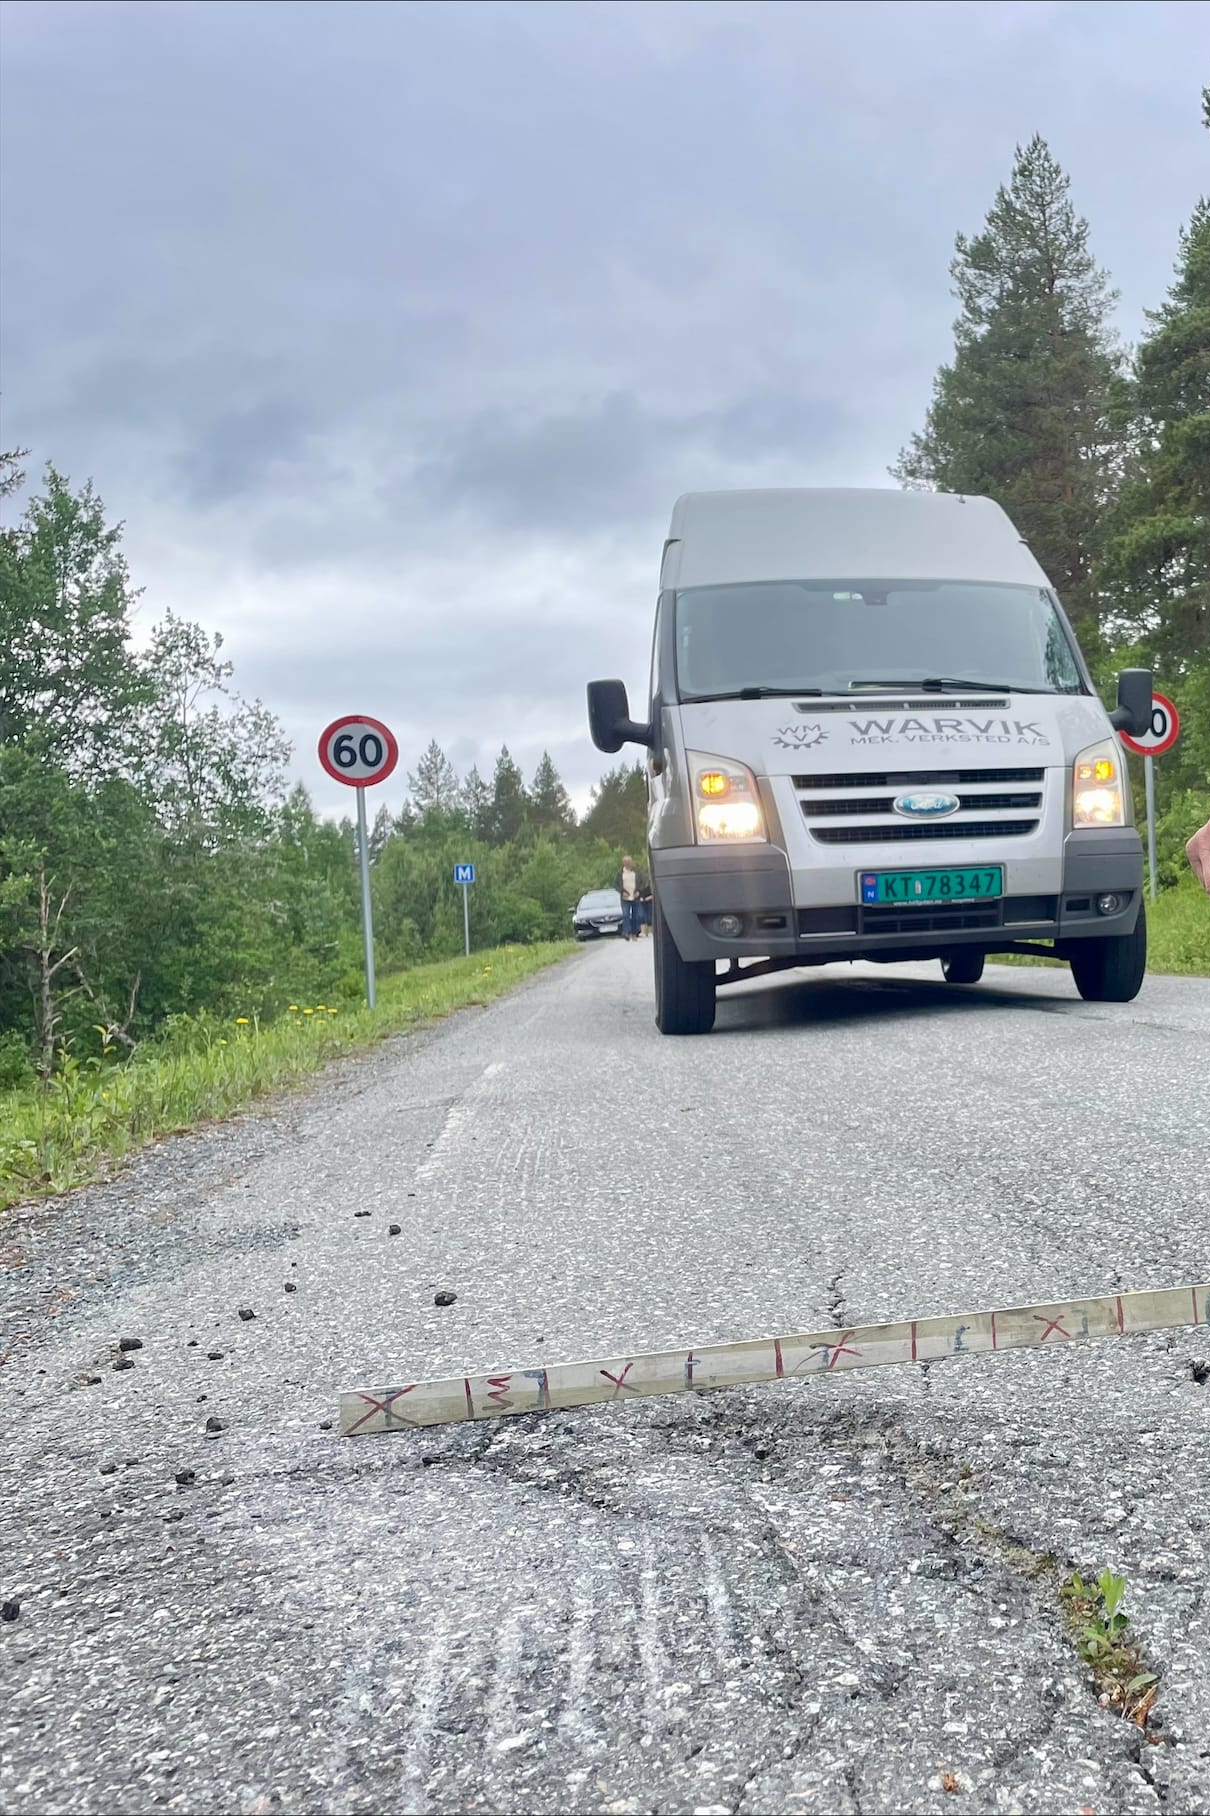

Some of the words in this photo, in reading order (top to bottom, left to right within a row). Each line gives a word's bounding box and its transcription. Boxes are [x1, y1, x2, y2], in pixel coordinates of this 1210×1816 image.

[847, 718, 1048, 738] WARVIK
[850, 735, 899, 745] MEK.
[904, 734, 1011, 744] VERKSTED
[1017, 736, 1051, 747] A/S
[333, 734, 383, 768] 60
[458, 867, 472, 881] M
[884, 877, 913, 898] KT
[924, 872, 996, 896] 78347
